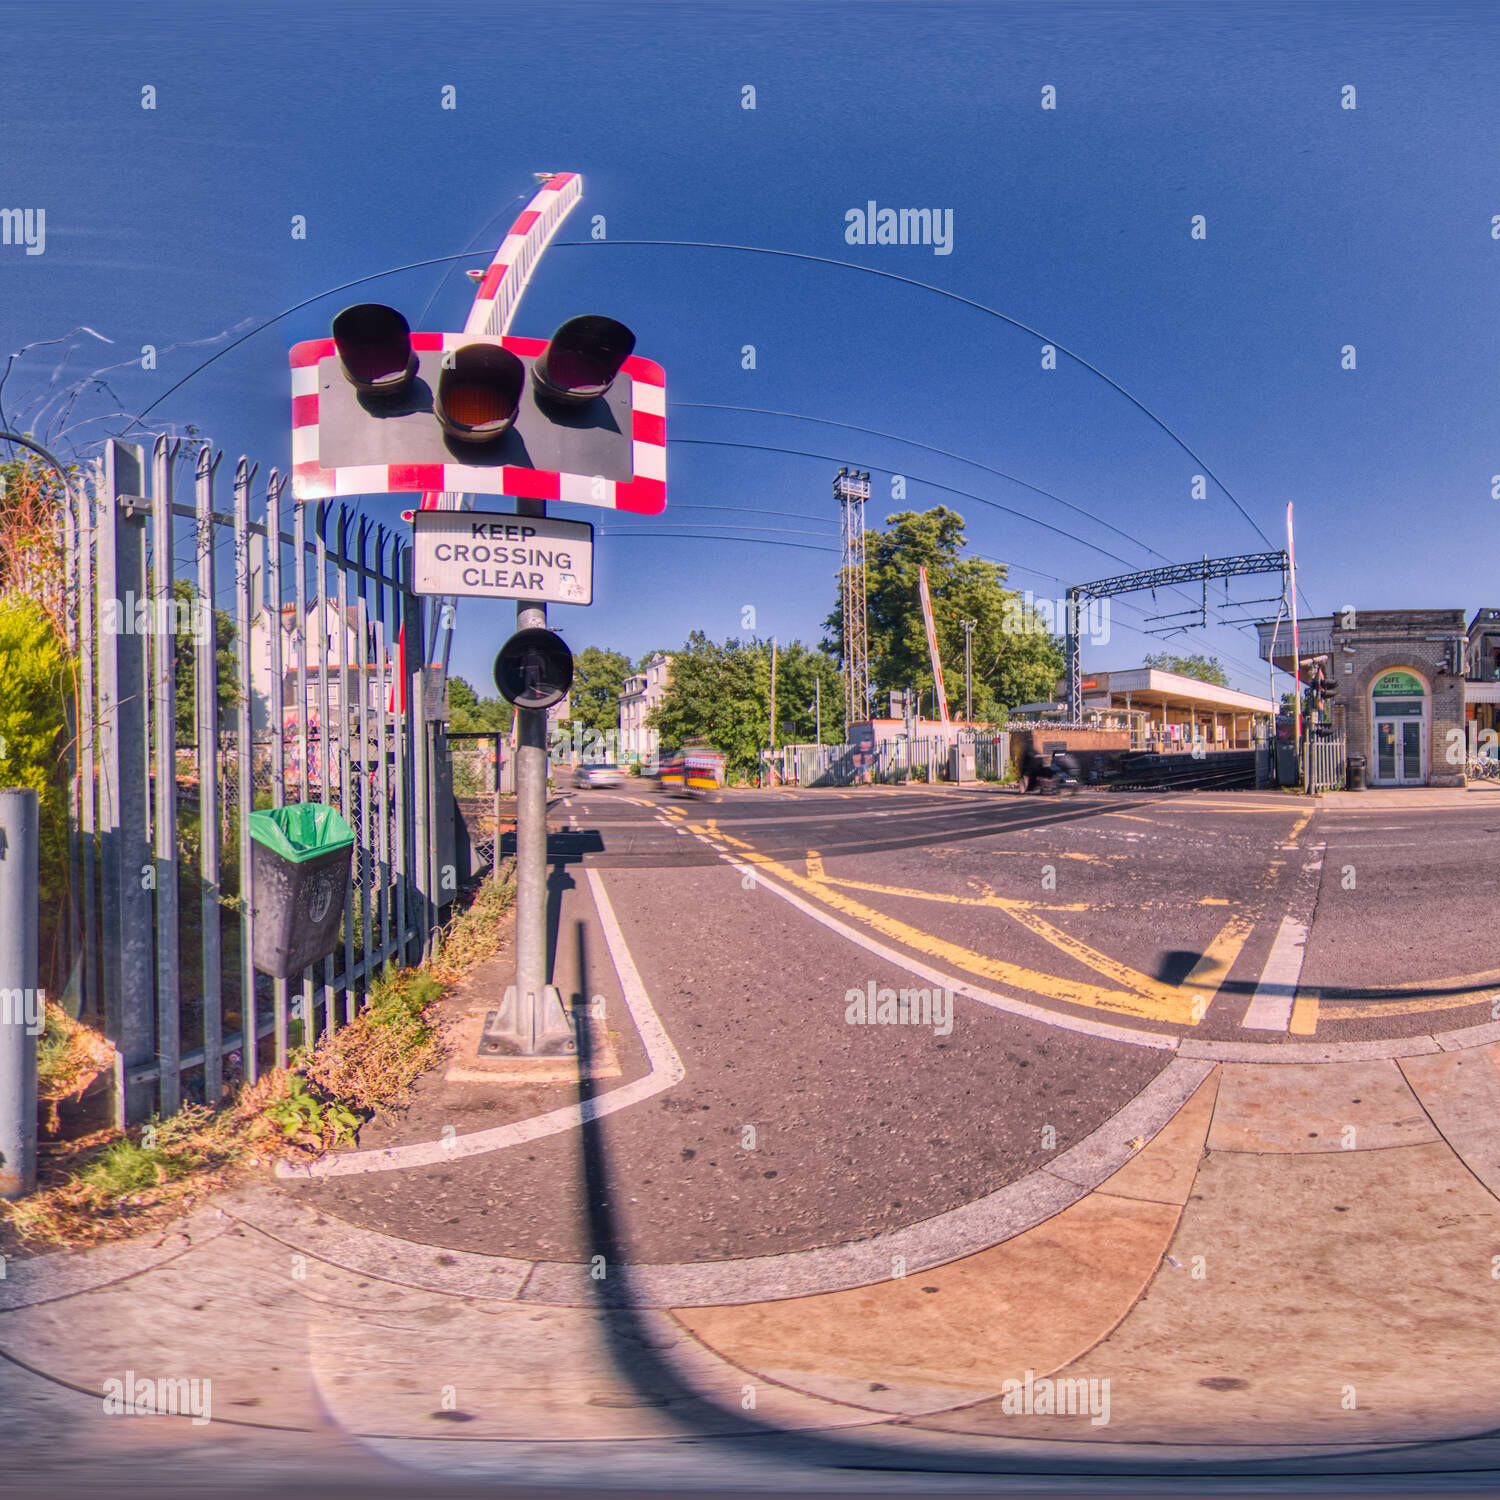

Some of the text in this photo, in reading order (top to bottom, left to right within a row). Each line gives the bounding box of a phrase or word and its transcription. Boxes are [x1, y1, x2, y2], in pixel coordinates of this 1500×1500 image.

[472, 523, 536, 543] KEEP
[434, 543, 572, 570] CROSSING
[462, 568, 544, 590] CLEAR
